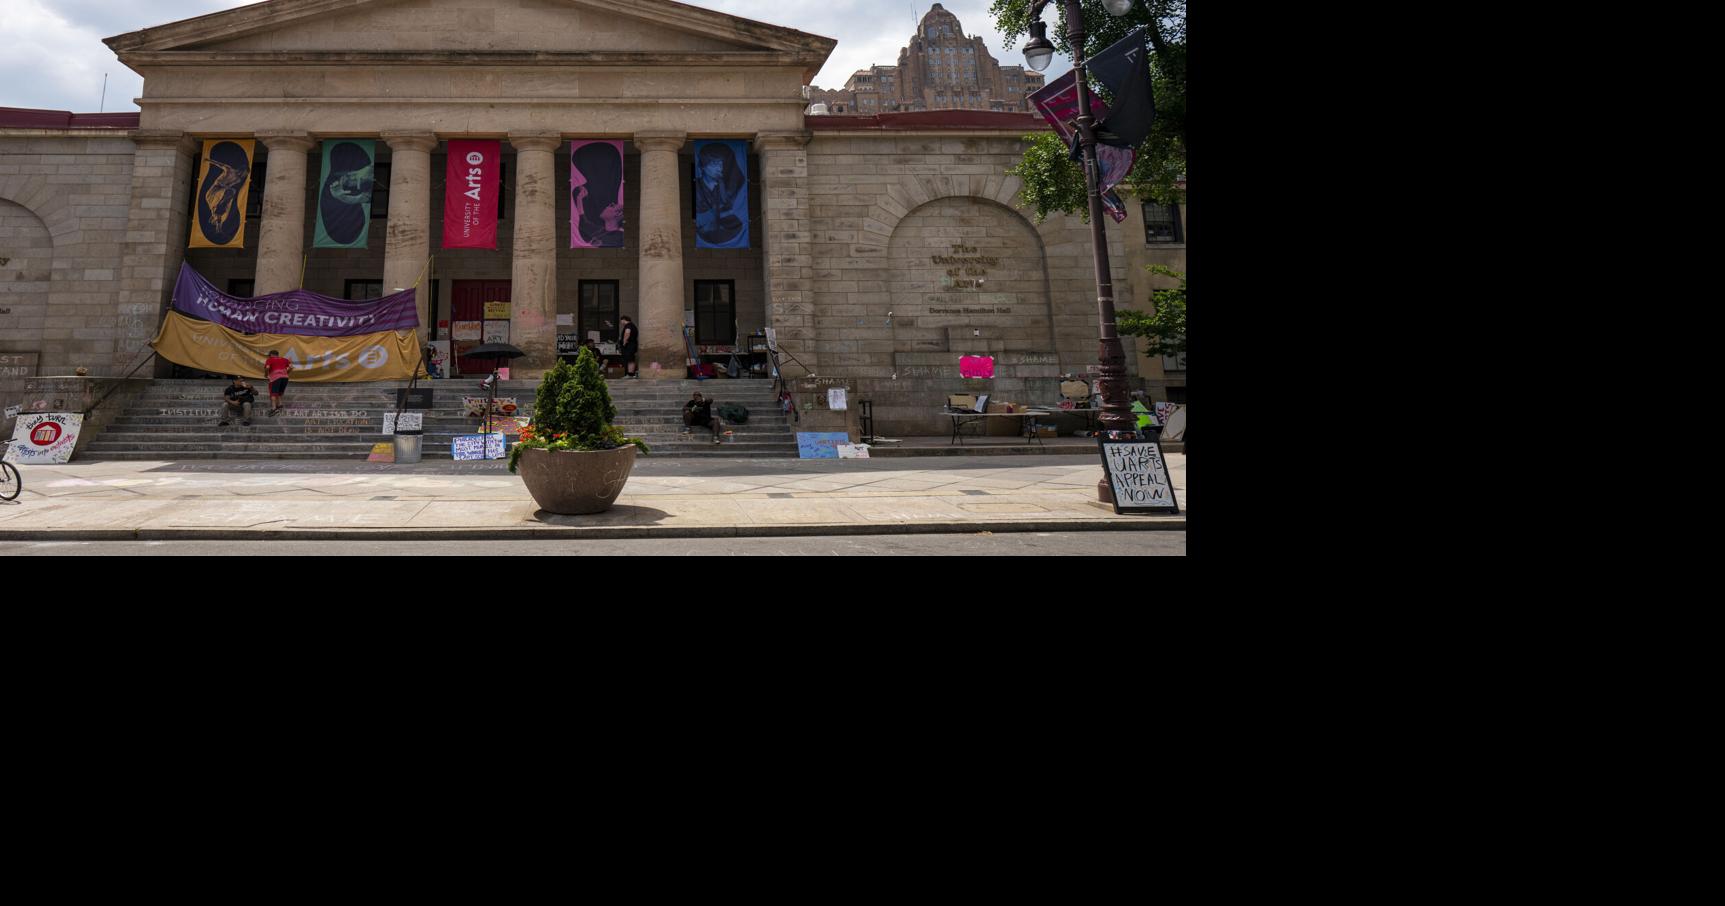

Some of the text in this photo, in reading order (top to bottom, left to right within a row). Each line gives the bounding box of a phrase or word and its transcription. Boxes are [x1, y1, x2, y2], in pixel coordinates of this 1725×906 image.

[463, 167, 482, 201] Arts
[463, 203, 471, 238] UNIVERSITY
[472, 203, 481, 225] OF THE
[952, 244, 978, 254] The
[932, 255, 999, 266] University
[946, 267, 986, 276] of the
[196, 293, 375, 328] HUMAN CREATIVIT
[283, 346, 351, 369] Arts
[1019, 354, 1056, 364] SHAME
[903, 366, 951, 377] SHAME
[1110, 446, 1157, 458] #SAVE
[1114, 456, 1162, 473] UARTS
[1115, 472, 1166, 488] APPEAL
[1124, 488, 1165, 502] NOW
